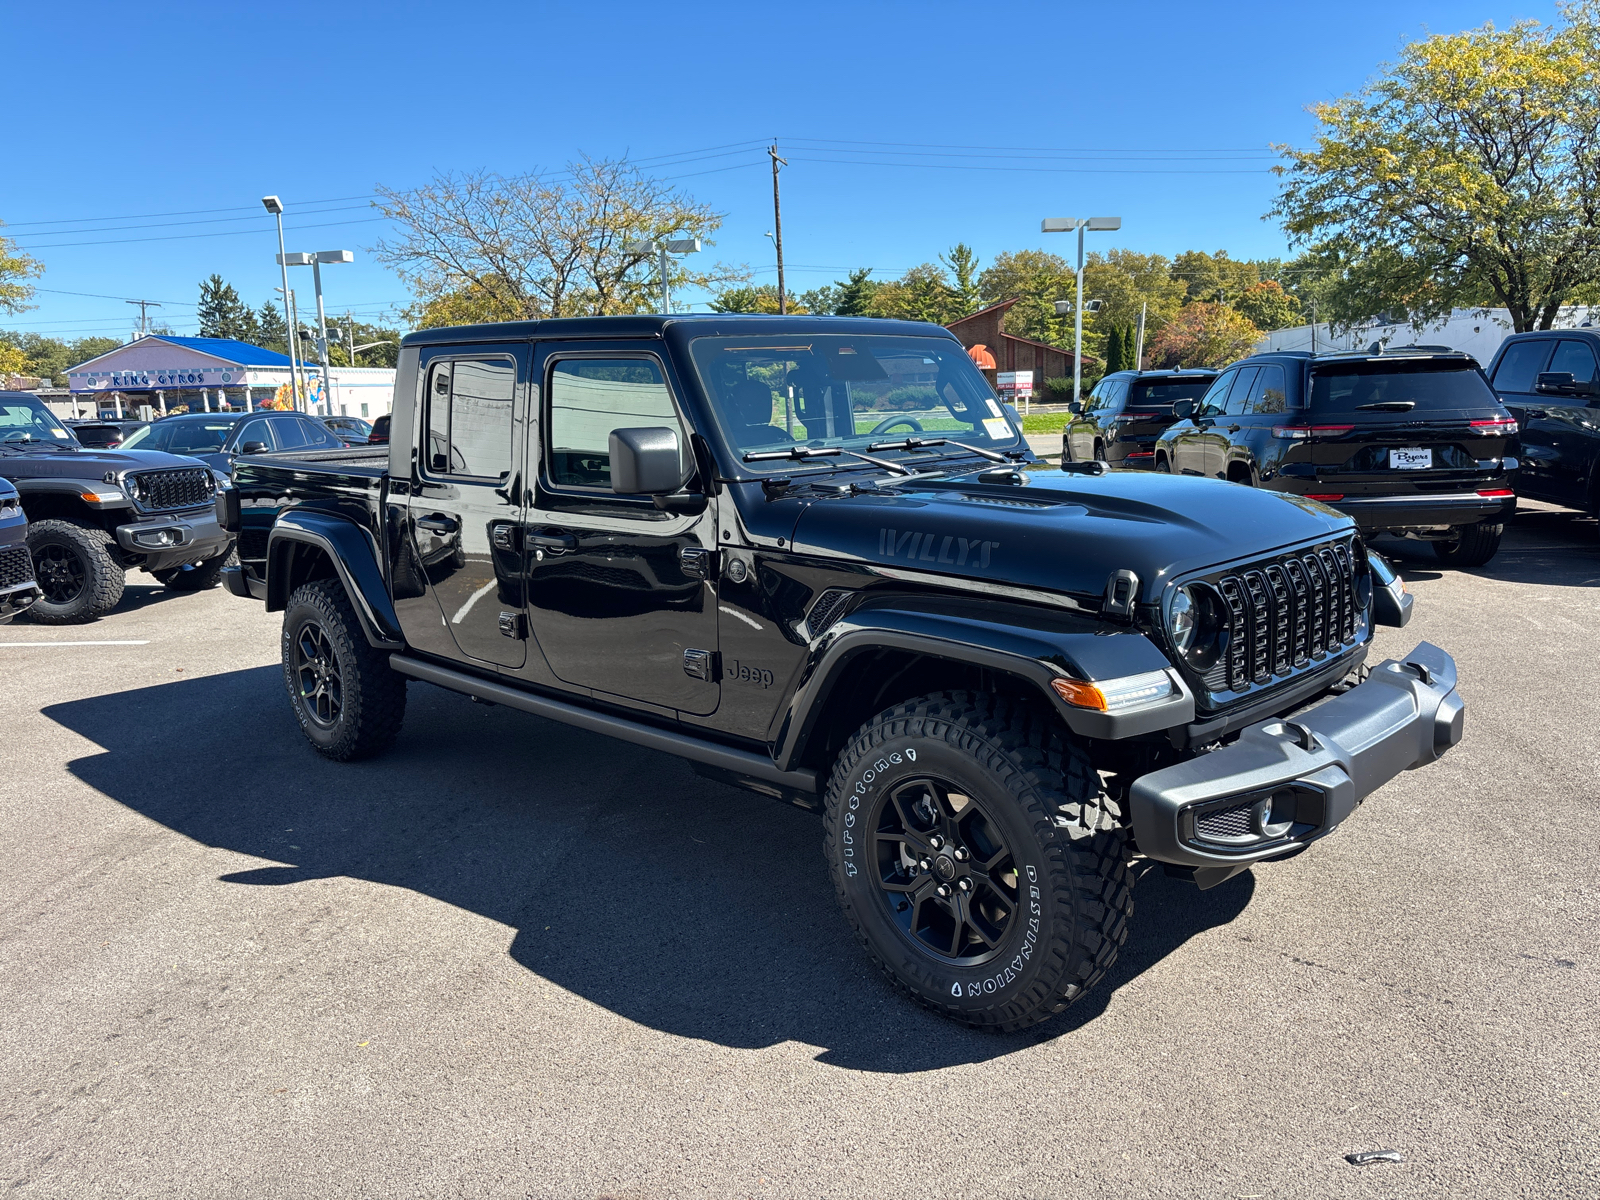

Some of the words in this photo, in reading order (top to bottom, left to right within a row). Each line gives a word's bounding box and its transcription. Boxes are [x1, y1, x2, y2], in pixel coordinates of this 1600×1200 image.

[112, 374, 149, 386] KING
[157, 373, 204, 386] GYROS
[1393, 451, 1428, 463] Byers
[879, 528, 1000, 569] WILLYS
[726, 659, 774, 689] Jeep
[843, 751, 903, 878] Firestone
[967, 864, 1041, 997] DESTINATION
